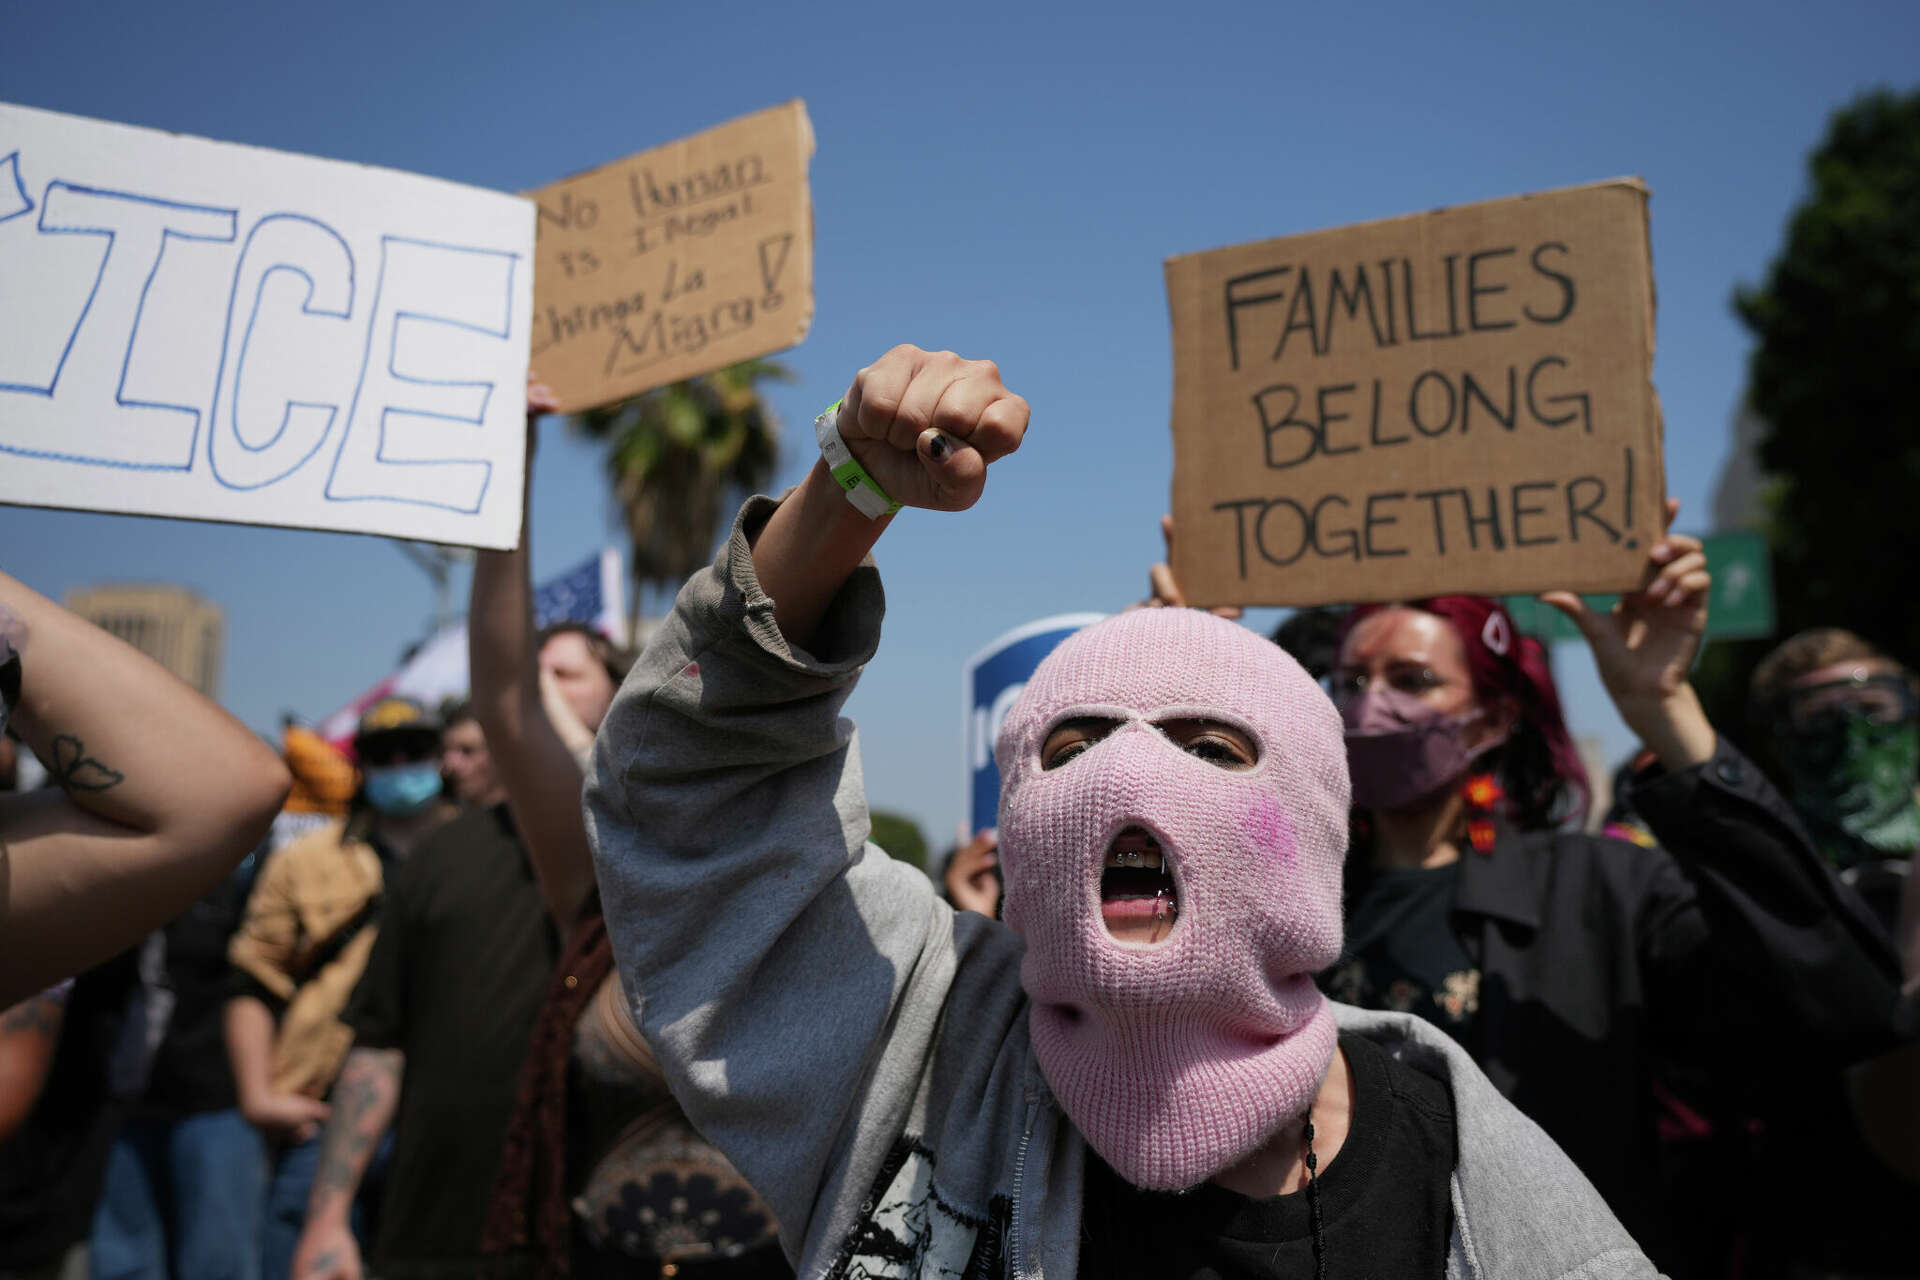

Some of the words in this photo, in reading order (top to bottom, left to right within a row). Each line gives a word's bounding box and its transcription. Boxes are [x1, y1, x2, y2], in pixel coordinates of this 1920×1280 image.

[536, 191, 599, 240] No
[629, 152, 768, 216] Human
[661, 259, 706, 303] La
[1223, 241, 1577, 372] FAMILIES
[0, 179, 523, 515] ICE
[1253, 355, 1594, 471] BELONG
[1211, 446, 1640, 581] TOGETHER!
